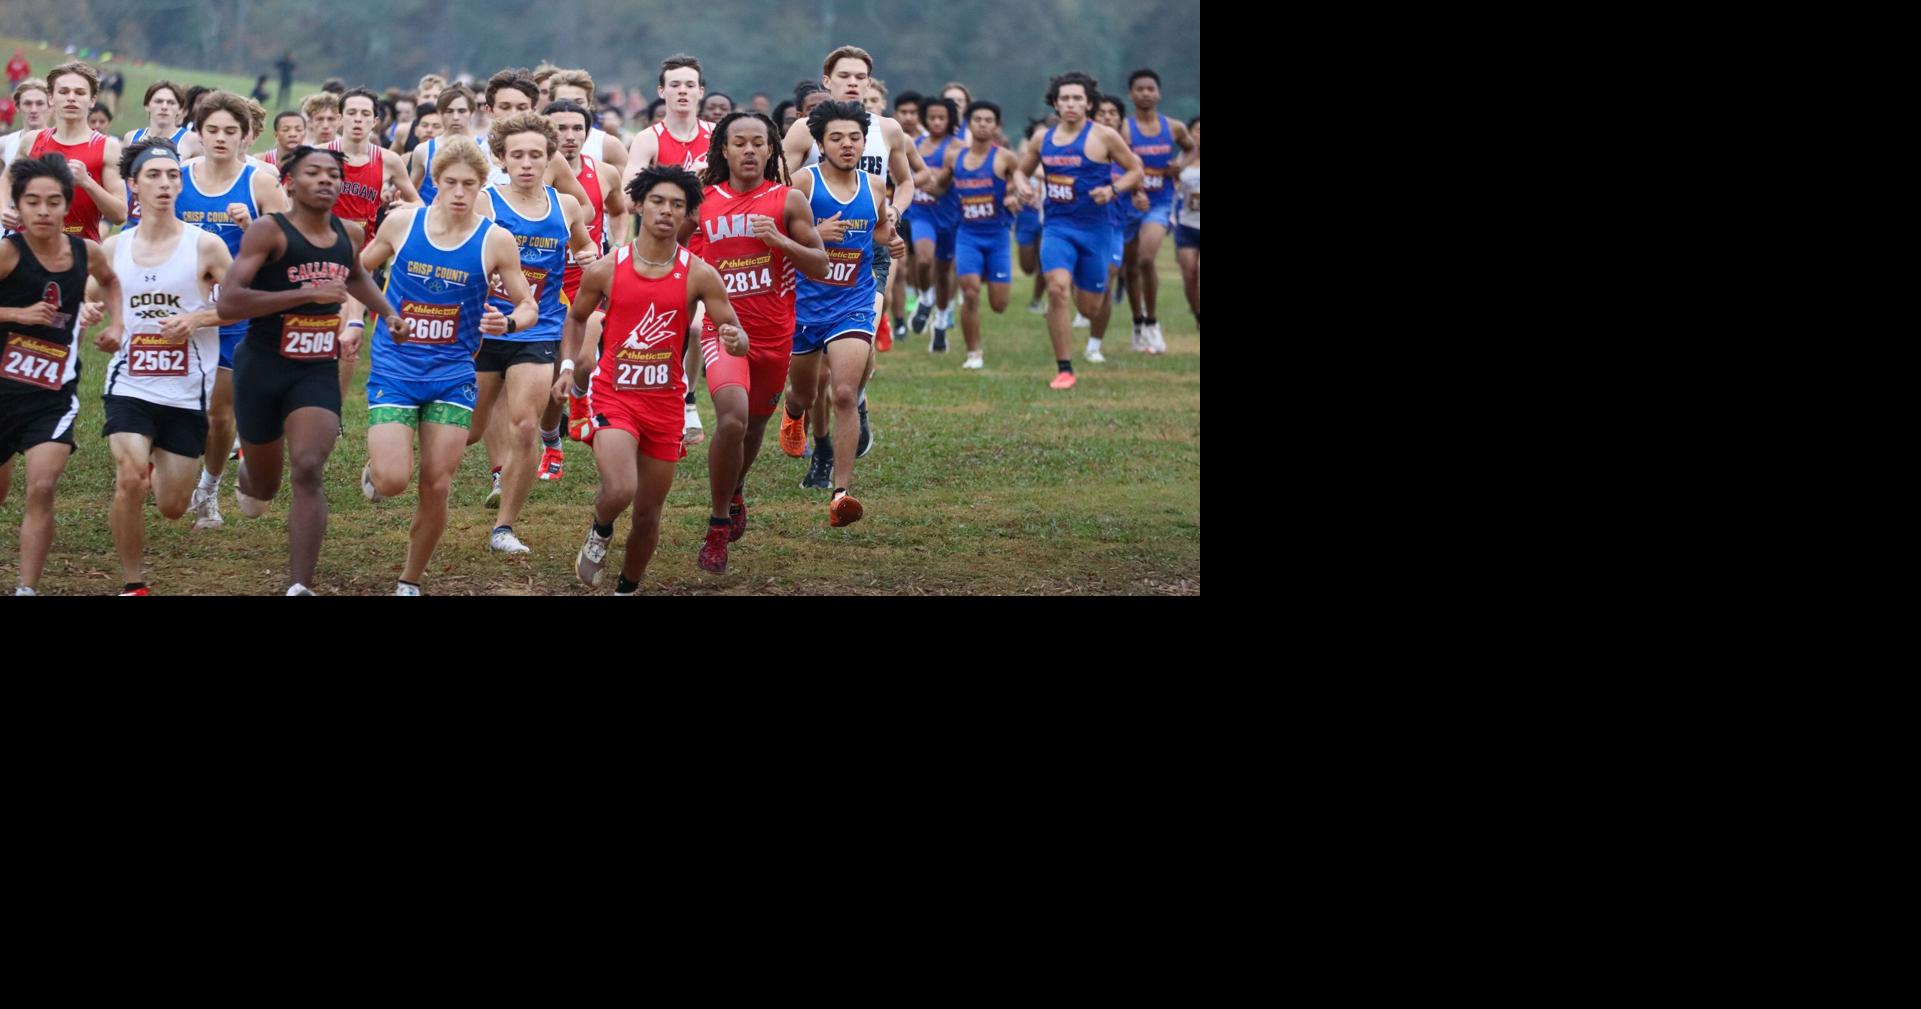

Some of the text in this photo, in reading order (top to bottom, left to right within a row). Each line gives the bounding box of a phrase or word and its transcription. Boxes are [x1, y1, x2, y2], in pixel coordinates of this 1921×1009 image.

[705, 213, 763, 244] LANE
[529, 236, 558, 249] COUNTY
[407, 260, 469, 283] CRISP COUNTY
[723, 268, 772, 293] 2814
[130, 292, 181, 309] COOK
[404, 317, 455, 339] 2606
[284, 331, 335, 353] 2509
[4, 351, 60, 384] 2474
[132, 350, 185, 371] 2562
[617, 363, 669, 385] 2708
